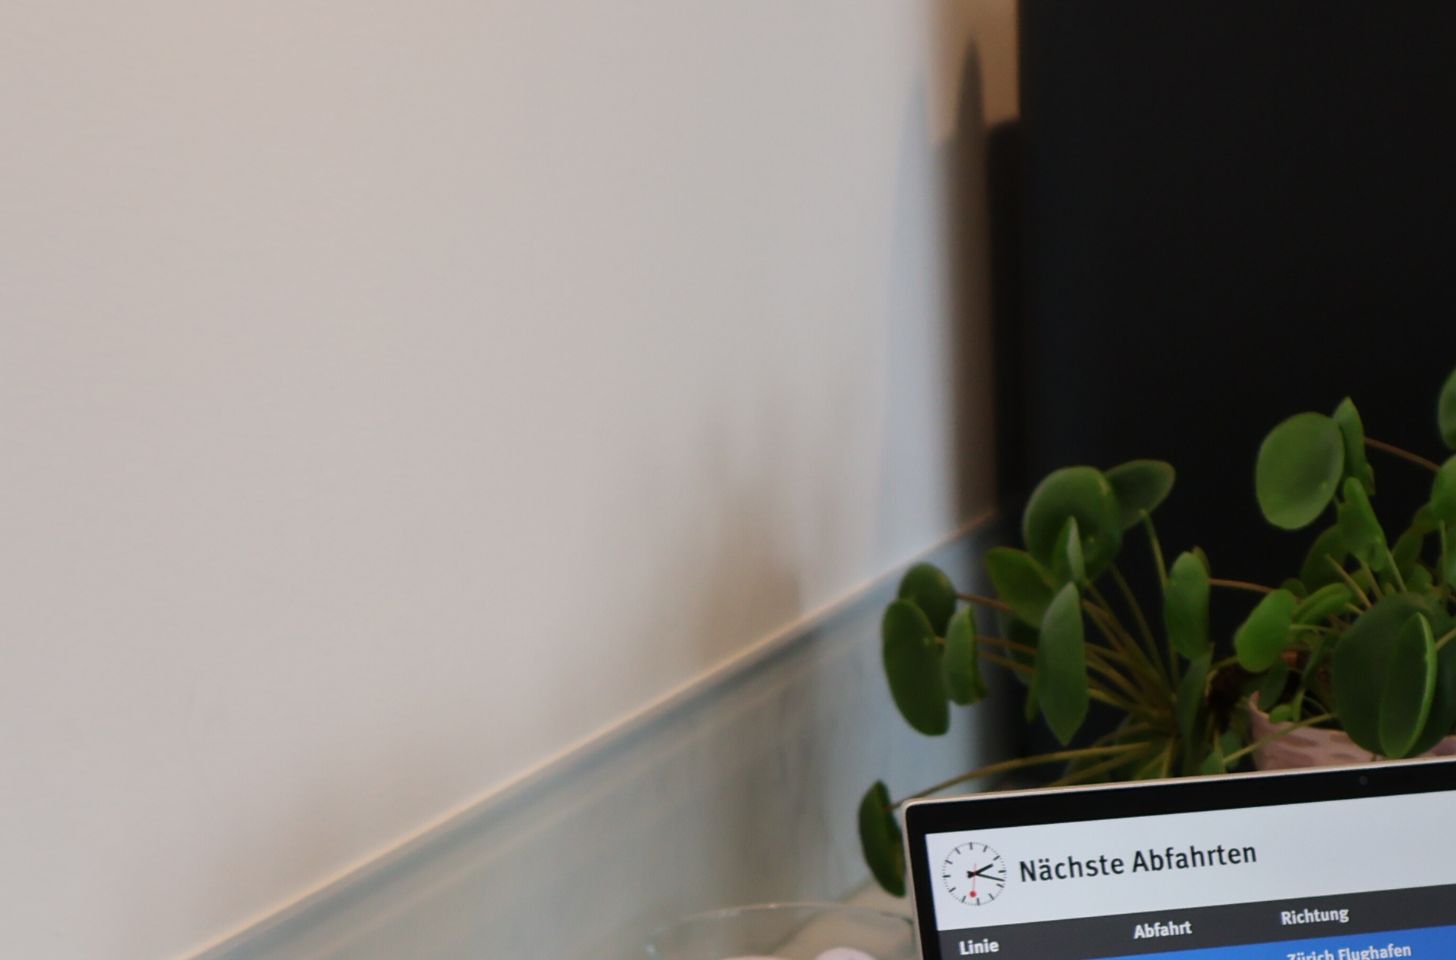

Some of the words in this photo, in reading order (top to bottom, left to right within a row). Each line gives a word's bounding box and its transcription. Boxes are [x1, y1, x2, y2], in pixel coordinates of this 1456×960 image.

[1020, 856, 1124, 882] Nächste
[1133, 845, 1256, 872] Abfahrten
[1280, 907, 1350, 927] Richtung
[1133, 921, 1193, 940] Abfahrt
[959, 938, 1000, 955] Linie
